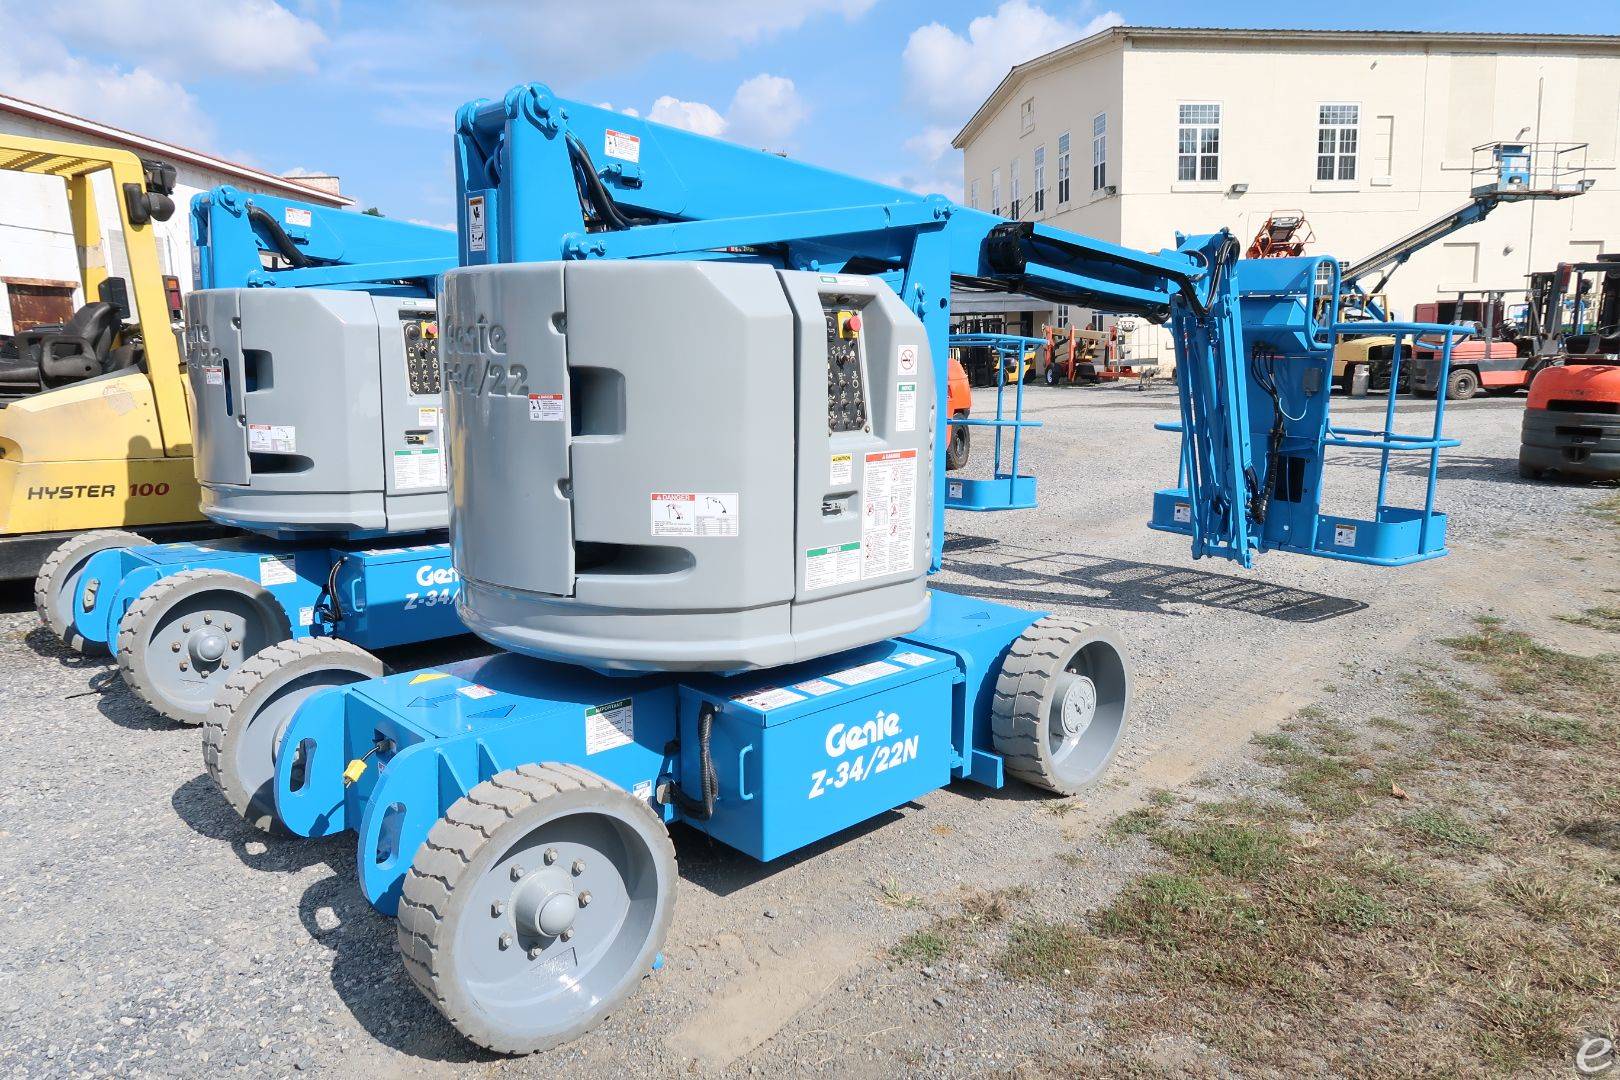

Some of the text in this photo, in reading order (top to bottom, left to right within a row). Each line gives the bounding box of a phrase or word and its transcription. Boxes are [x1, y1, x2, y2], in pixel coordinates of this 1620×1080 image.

[28, 482, 170, 500] HYSTER 100
[825, 710, 902, 758] Genie
[808, 735, 920, 800] Z-34/22N
